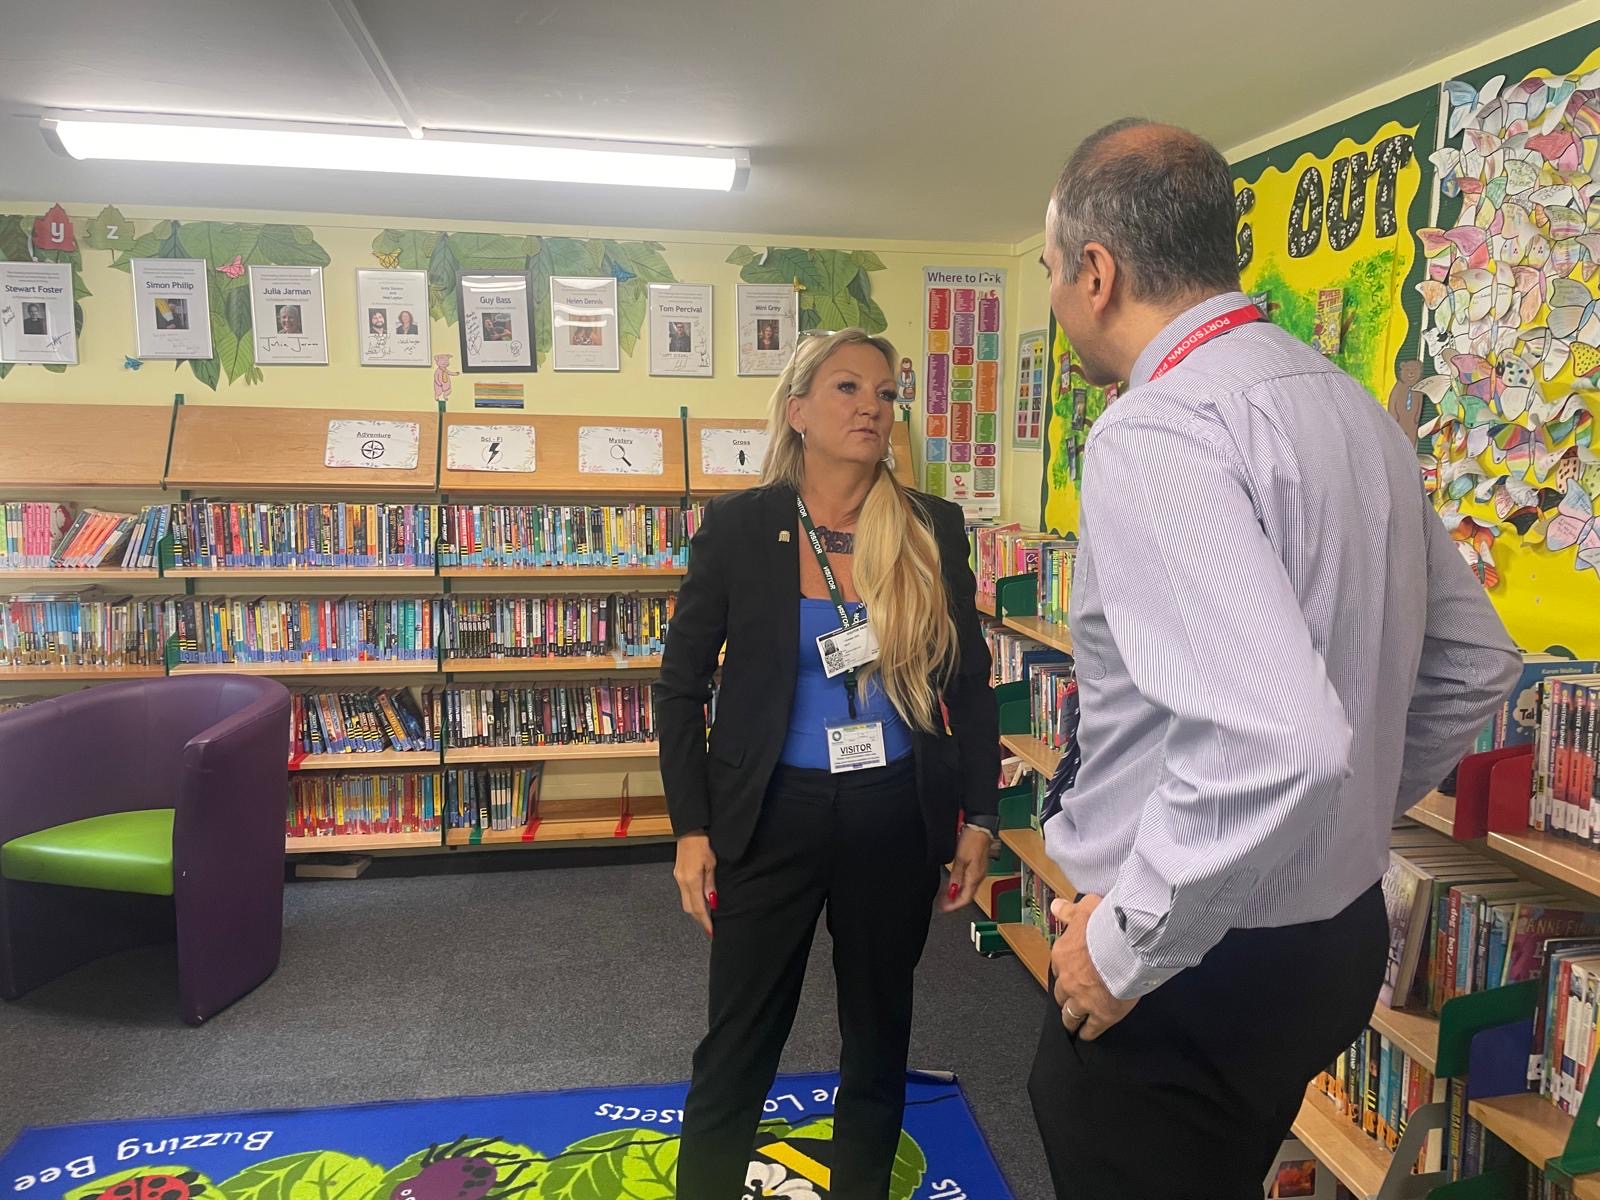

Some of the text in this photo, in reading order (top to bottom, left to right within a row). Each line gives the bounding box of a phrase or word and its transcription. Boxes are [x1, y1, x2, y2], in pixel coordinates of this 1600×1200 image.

[1288, 135, 1414, 257] OUT
[172, 281, 194, 290] Philip
[927, 272, 962, 283] Where
[965, 274, 976, 283] to
[5, 284, 36, 292] Stewart
[480, 296, 512, 305] Guy Bass
[1167, 317, 1231, 362] PORTSDOWN
[808, 529, 823, 555] VISITOR
[822, 566, 836, 590] VISITOR
[836, 604, 850, 628] VISITOR
[1519, 707, 1535, 721] Tal
[840, 743, 872, 755] VISITOR
[14, 1130, 274, 1191] Buzzing Bee
